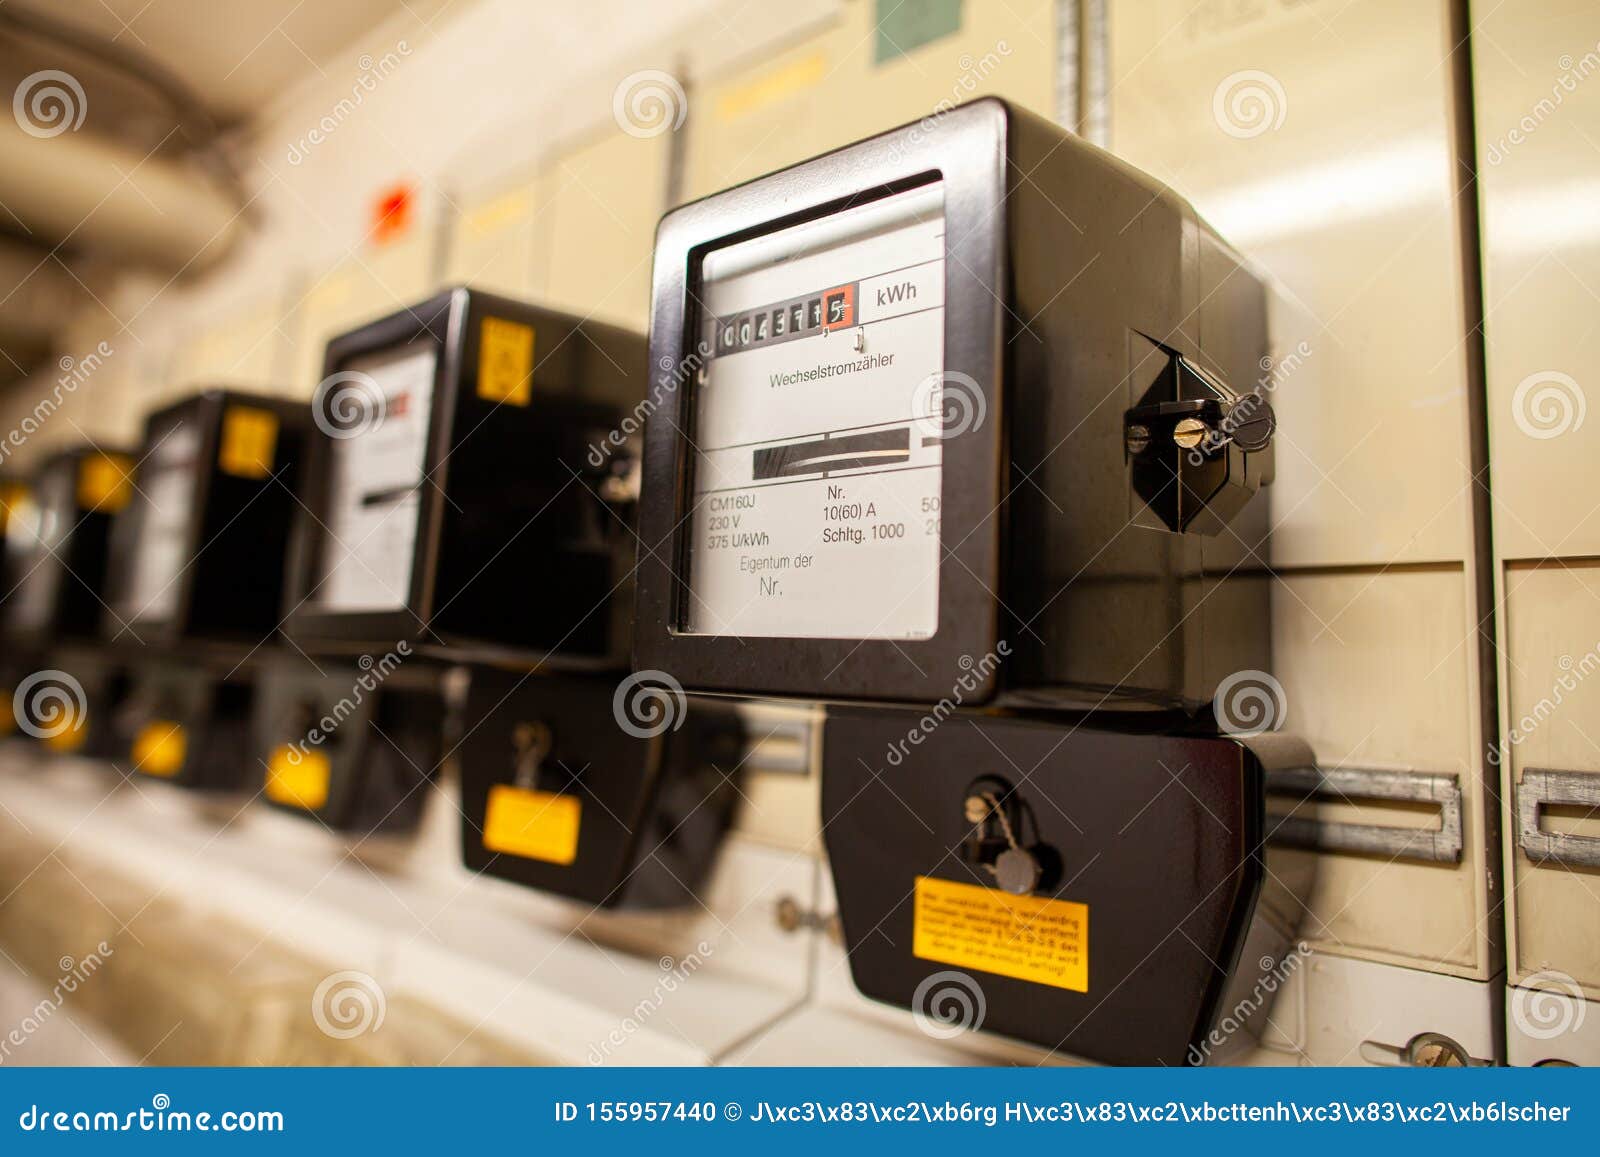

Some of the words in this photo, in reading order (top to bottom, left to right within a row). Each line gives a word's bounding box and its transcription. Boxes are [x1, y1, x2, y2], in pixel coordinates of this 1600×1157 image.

[877, 282, 917, 306] kWh
[770, 353, 894, 388] Wechselstromzähler
[828, 486, 846, 500] Nr.
[710, 495, 756, 511] CM160J
[824, 504, 862, 522] 10(60)
[866, 503, 876, 516] A
[709, 518, 729, 530] 230
[732, 516, 740, 527] V
[708, 536, 728, 550] 375
[732, 531, 769, 547] U/kWh
[823, 528, 866, 545] Schltg.
[872, 524, 905, 539] 1000
[740, 557, 790, 573] Eigentum
[794, 553, 813, 568] der
[760, 577, 783, 596] Nr.
